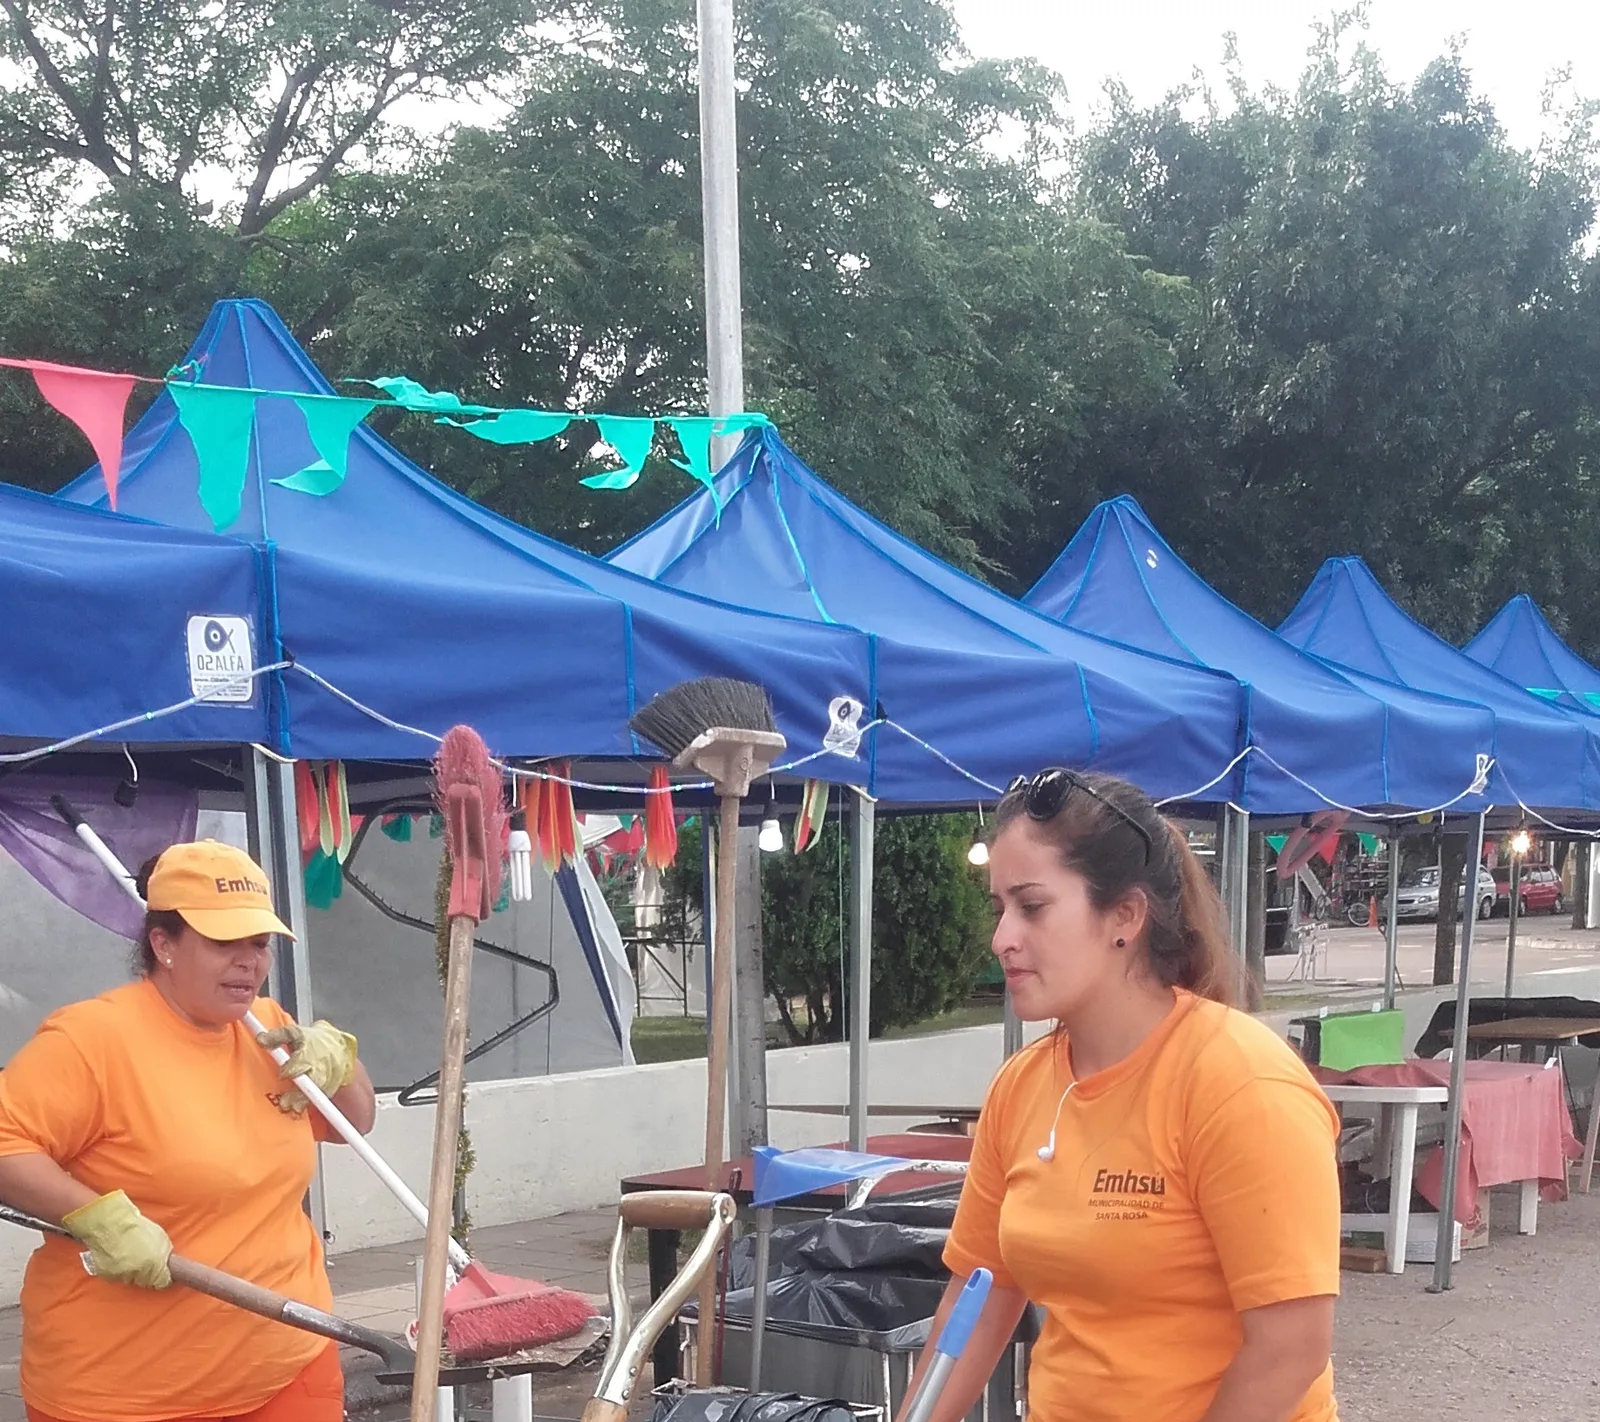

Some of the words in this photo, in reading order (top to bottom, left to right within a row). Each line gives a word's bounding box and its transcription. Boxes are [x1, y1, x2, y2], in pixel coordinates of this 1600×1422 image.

[1092, 1168, 1165, 1196] Emhsu
[1087, 1198, 1150, 1209] MUNICIPALIDAD
[1152, 1201, 1165, 1210] DE
[1095, 1212, 1120, 1221] SANTA
[1122, 1210, 1149, 1221] ROSA
